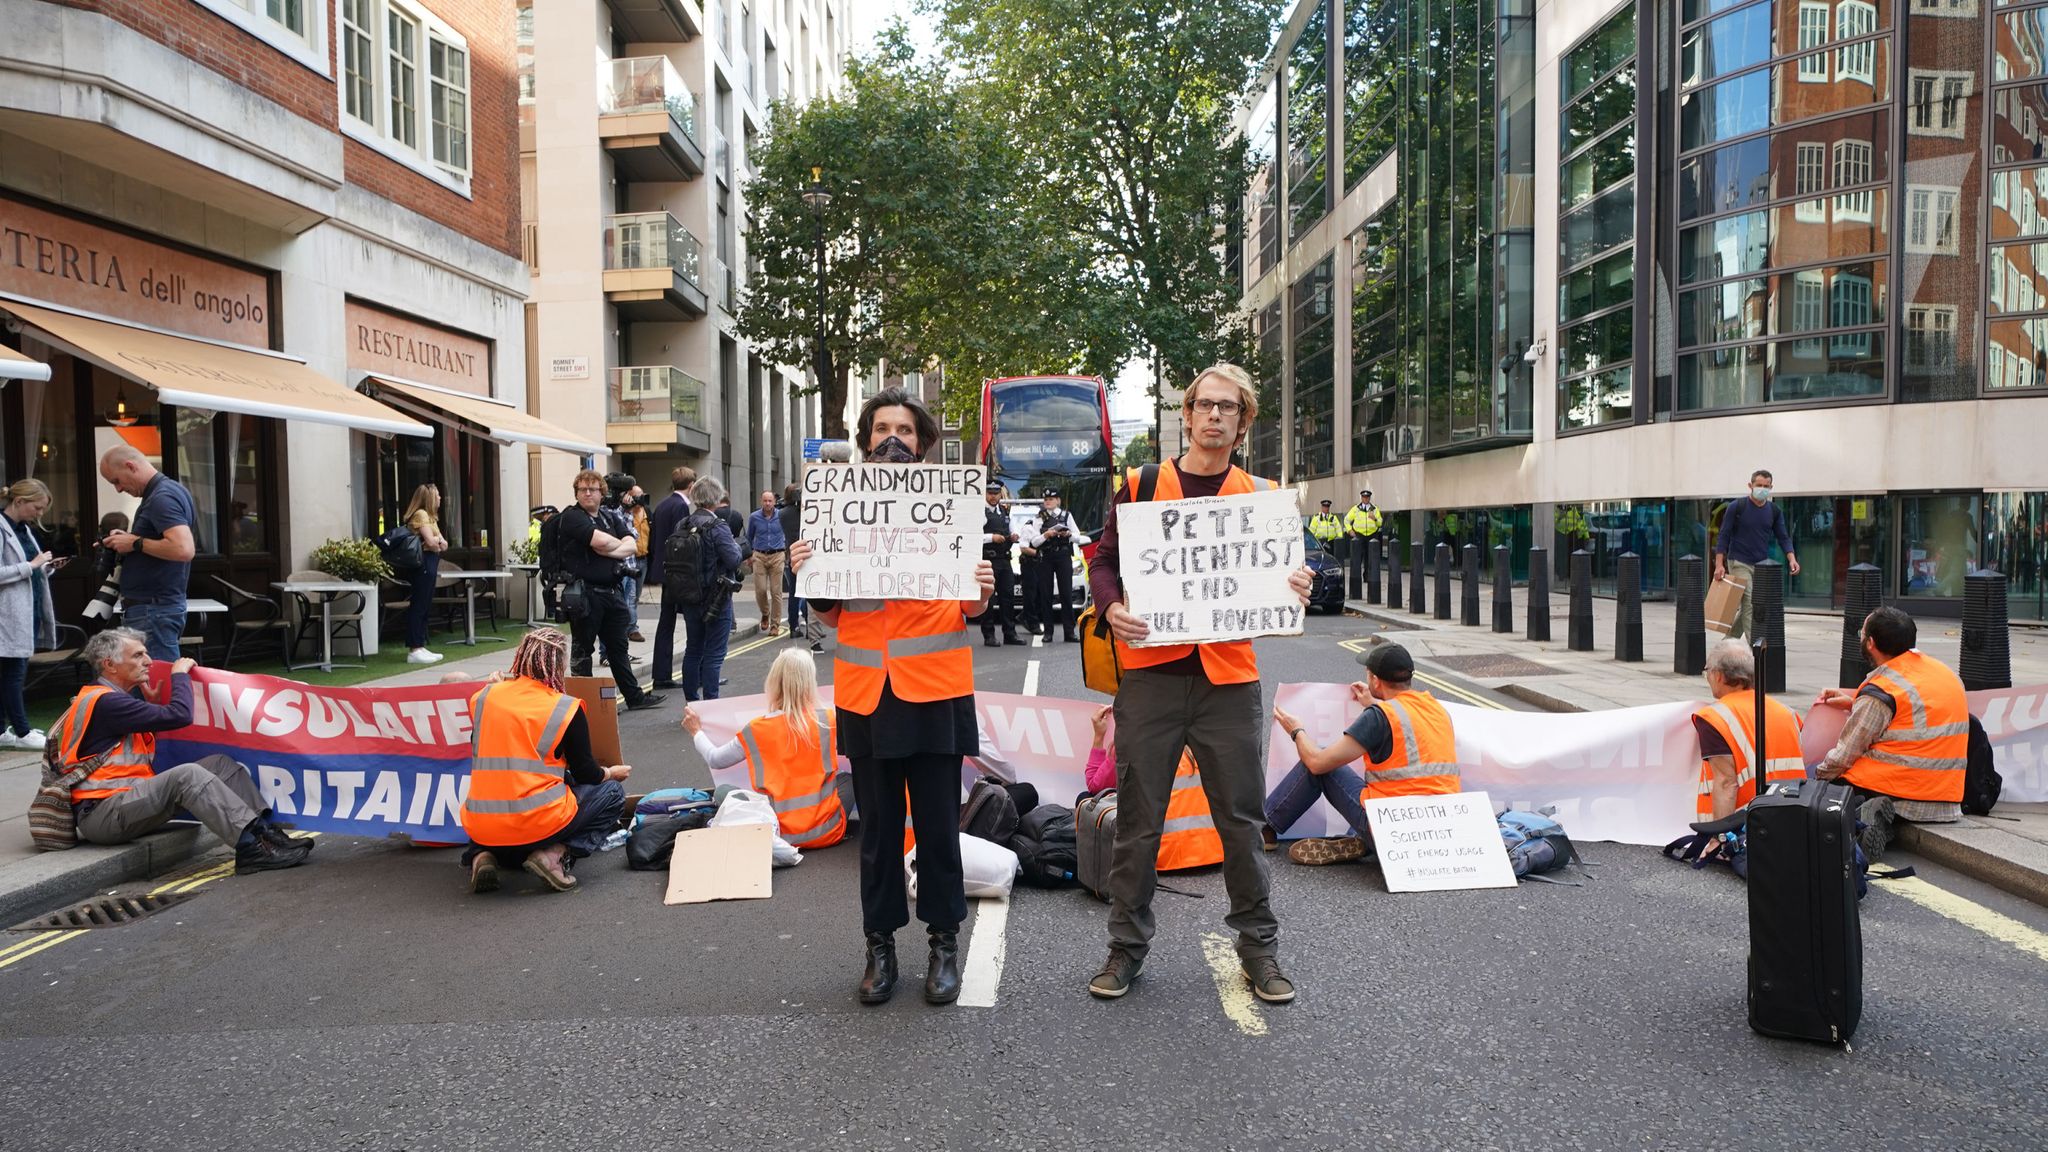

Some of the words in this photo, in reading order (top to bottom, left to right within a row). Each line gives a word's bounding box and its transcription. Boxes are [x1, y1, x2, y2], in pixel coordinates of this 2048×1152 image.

[0, 227, 127, 293] TERIA
[140, 268, 186, 305] dell'
[194, 294, 263, 324] angolo
[357, 325, 475, 377] RESTAURANT
[1043, 445, 1057, 454] Fields
[1071, 440, 1089, 456] 88
[804, 467, 982, 495] GRANDMOTHER
[842, 500, 896, 525] CUT
[1160, 506, 1255, 541] PETE
[1265, 515, 1299, 534] (33)
[823, 528, 844, 553] the
[848, 527, 938, 555] LIVES
[949, 535, 963, 559] of
[1139, 536, 1300, 576] SCIENTIST
[1181, 576, 1239, 601] END
[1212, 605, 1302, 632] POVERTY
[191, 680, 473, 746] INSULATE
[236, 761, 472, 827] RITAIN
[1377, 804, 1447, 825] MEREDITH
[1390, 828, 1454, 844] SCIENTIST
[1387, 850, 1410, 862] CUT
[1417, 848, 1449, 859] ENERGY
[1455, 847, 1485, 857] USAGE
